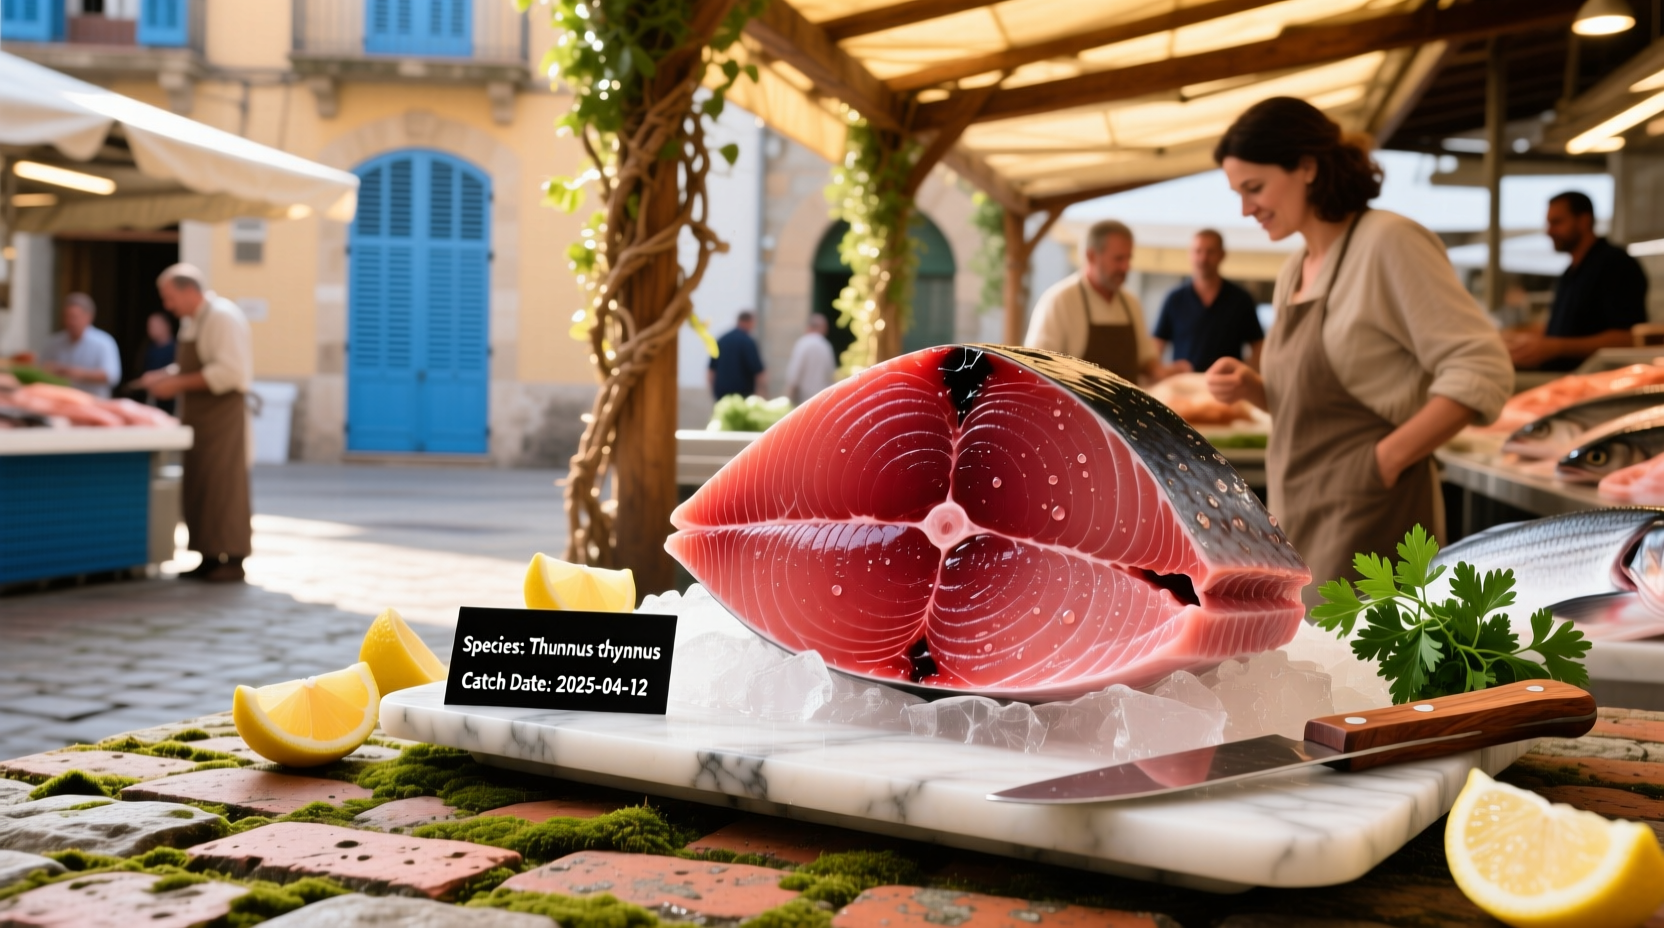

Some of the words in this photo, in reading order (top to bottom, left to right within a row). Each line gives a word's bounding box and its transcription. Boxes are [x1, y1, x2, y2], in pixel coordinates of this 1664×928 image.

[463, 635, 525, 657] Species:
[529, 637, 594, 657] Thunnus
[461, 671, 506, 690] Catch
[509, 673, 552, 692] Date:
[555, 675, 648, 696] 2025-04-12
